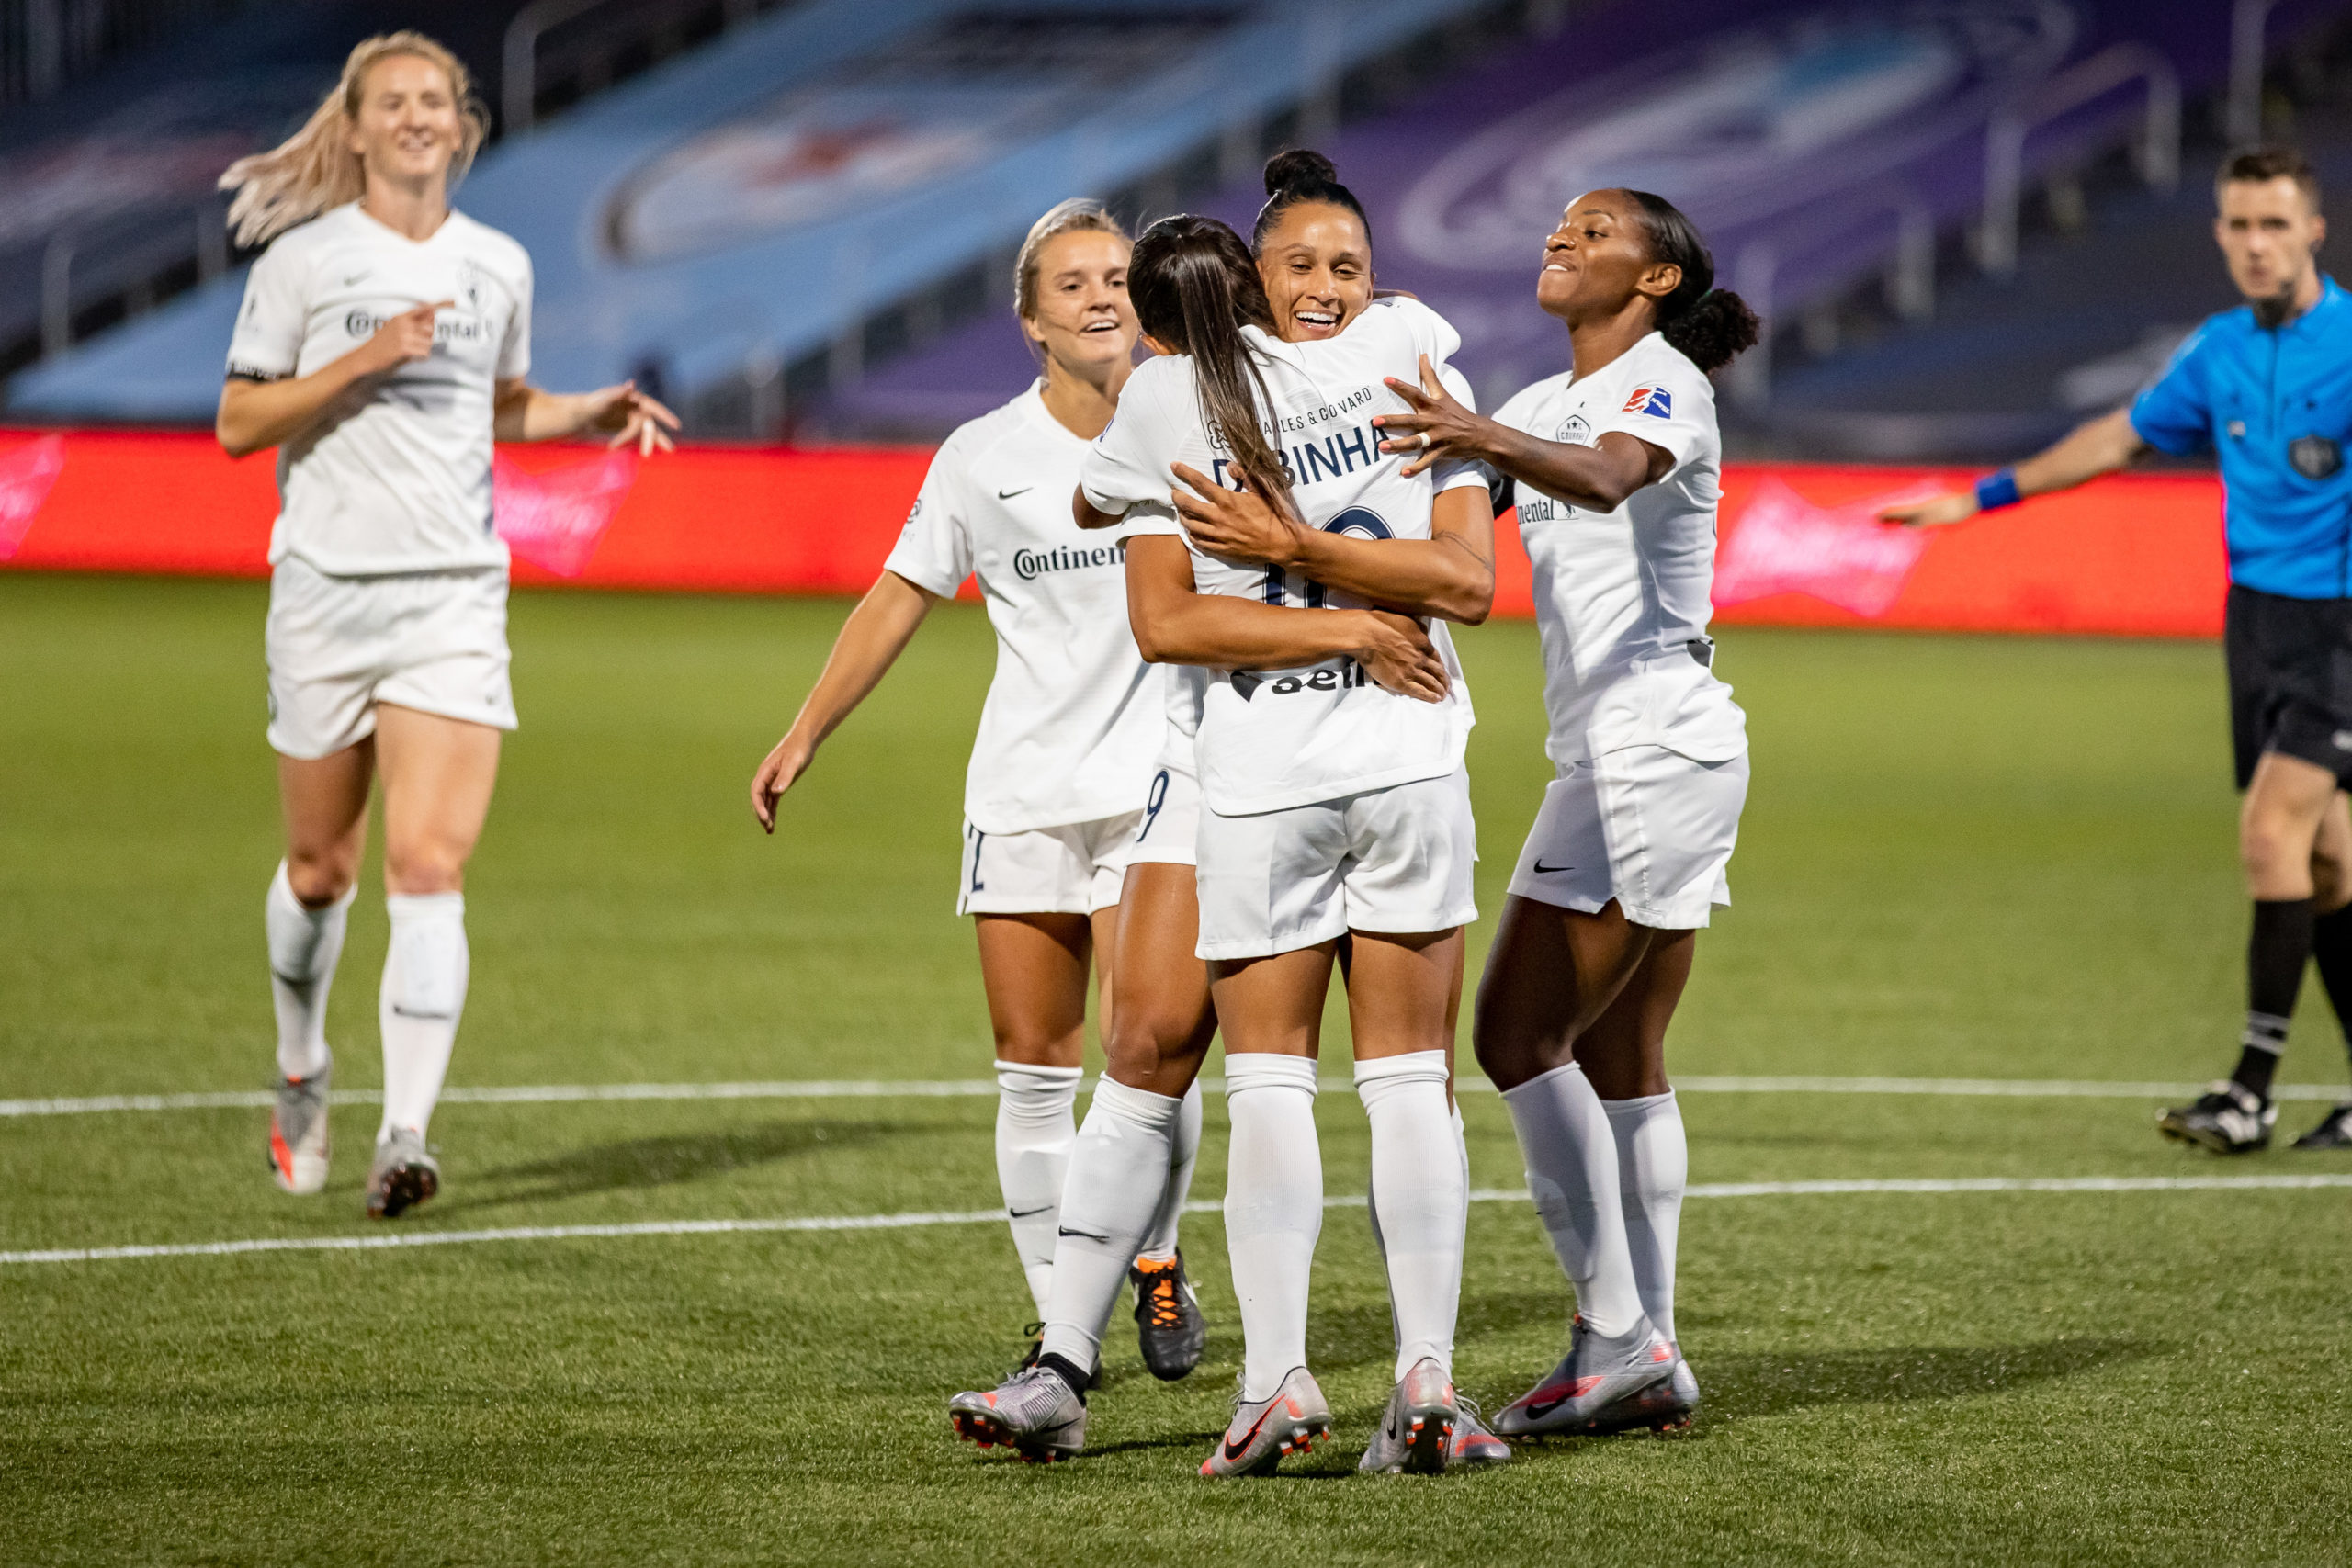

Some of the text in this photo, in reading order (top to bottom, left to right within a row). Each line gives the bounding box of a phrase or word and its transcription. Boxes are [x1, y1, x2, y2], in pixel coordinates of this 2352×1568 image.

[1307, 412, 1318, 425] &
[1319, 387, 1372, 421] COVARD
[1213, 419, 1390, 492] DBINHA
[1013, 546, 1125, 581] Continen
[1136, 769, 1170, 843] 9
